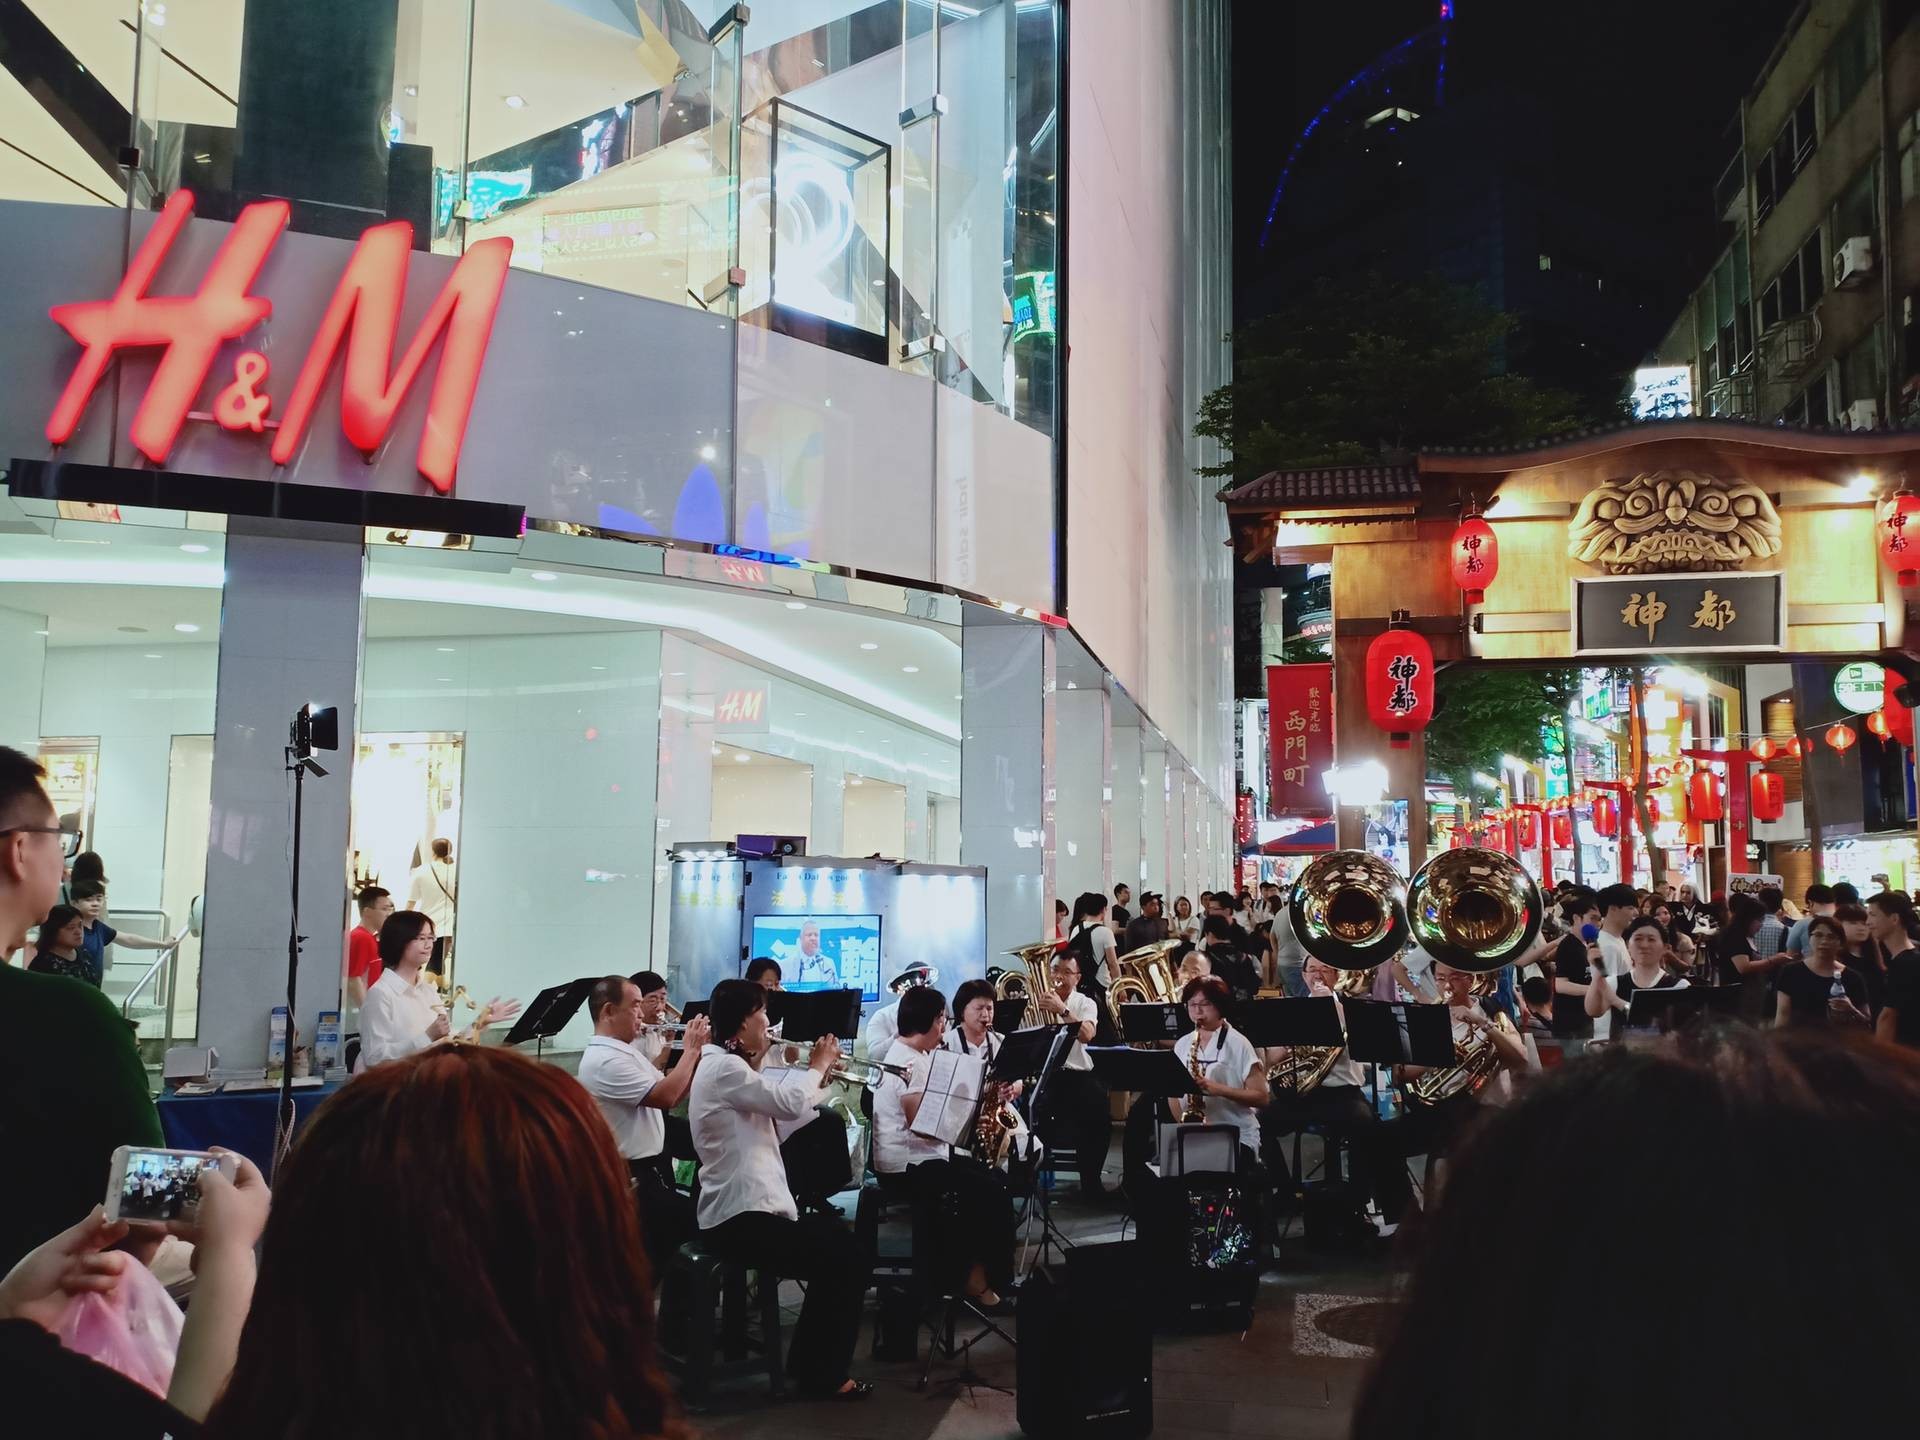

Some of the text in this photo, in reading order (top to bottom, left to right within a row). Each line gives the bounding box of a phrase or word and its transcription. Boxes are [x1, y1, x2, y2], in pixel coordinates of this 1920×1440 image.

[45, 188, 513, 495] H&M
[1461, 535, 1485, 575] 神都
[1885, 511, 1910, 554] 神都
[1620, 589, 1738, 644] 神都
[719, 688, 764, 723] H&M
[1387, 654, 1418, 715] 神都
[1282, 709, 1311, 788] 西門町
